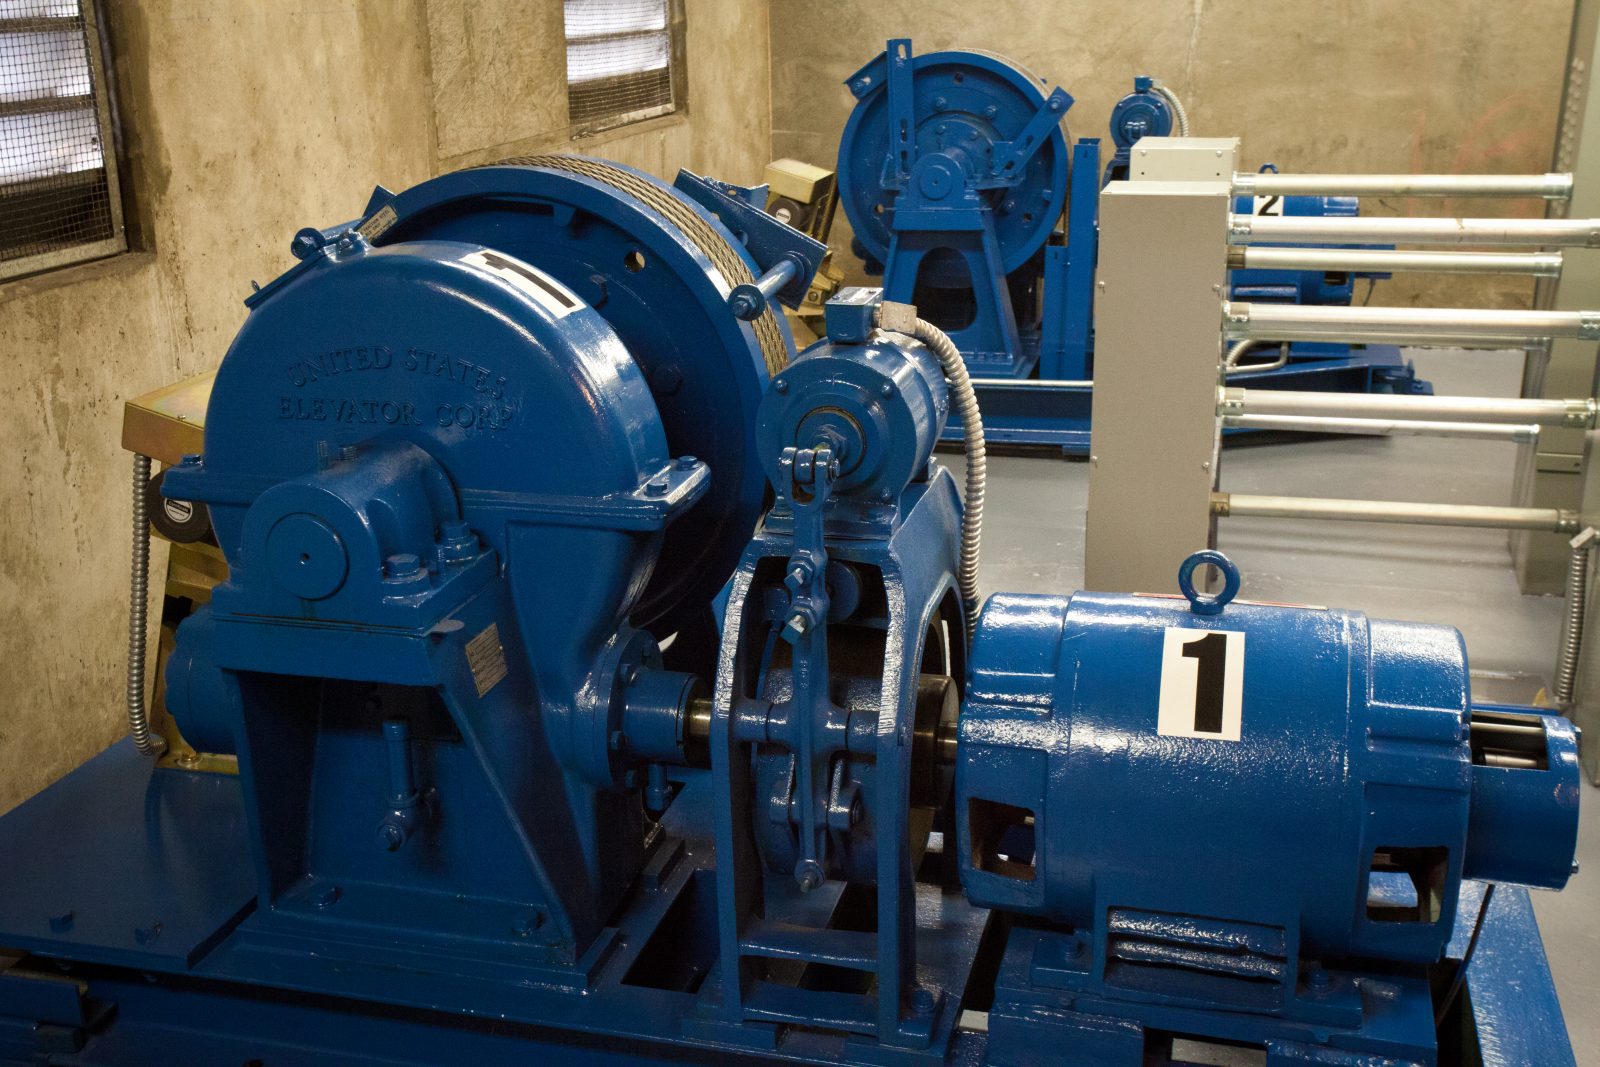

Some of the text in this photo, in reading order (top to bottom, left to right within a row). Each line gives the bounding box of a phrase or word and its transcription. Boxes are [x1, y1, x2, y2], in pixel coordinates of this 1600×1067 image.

[1258, 194, 1279, 216] 2
[481, 253, 576, 308] 1
[287, 346, 506, 399] UNITED STATES
[279, 397, 513, 430] ELEVATOR CORP
[1182, 633, 1227, 733] 1
